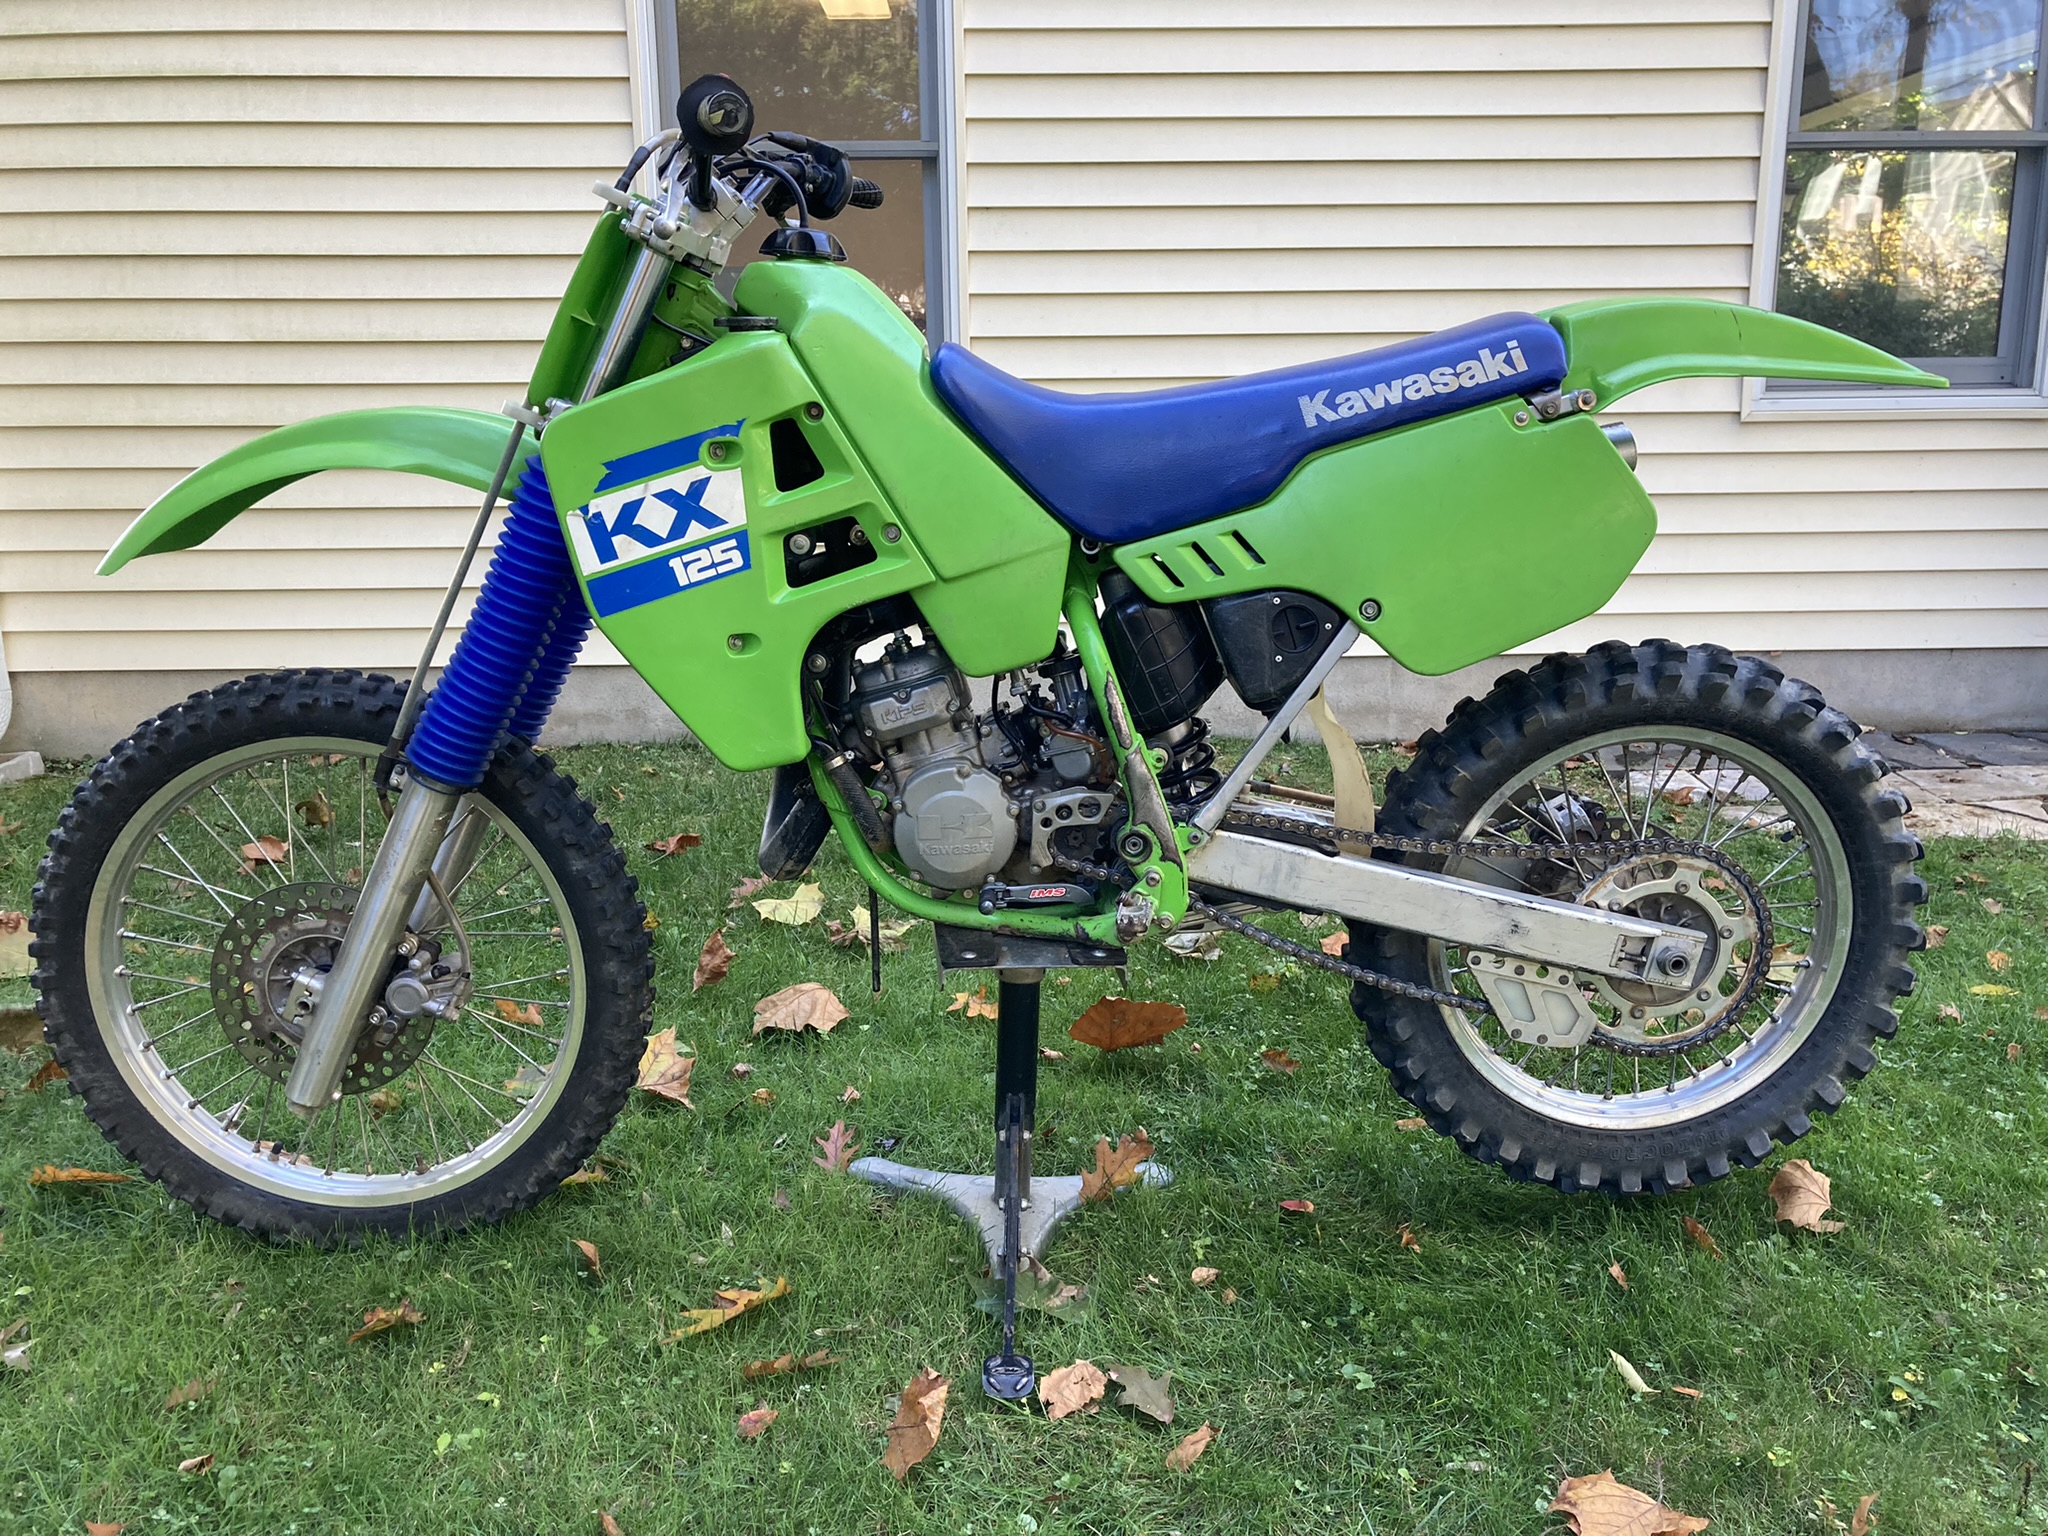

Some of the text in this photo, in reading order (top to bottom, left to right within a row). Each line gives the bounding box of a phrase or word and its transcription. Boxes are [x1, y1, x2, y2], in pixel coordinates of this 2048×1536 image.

[1297, 339, 1529, 429] Kawasaki
[578, 475, 729, 565] KX
[668, 538, 744, 587] 125
[880, 700, 928, 725] KIPS
[919, 840, 994, 856] Kawasaki
[1029, 887, 1066, 899] IMS
